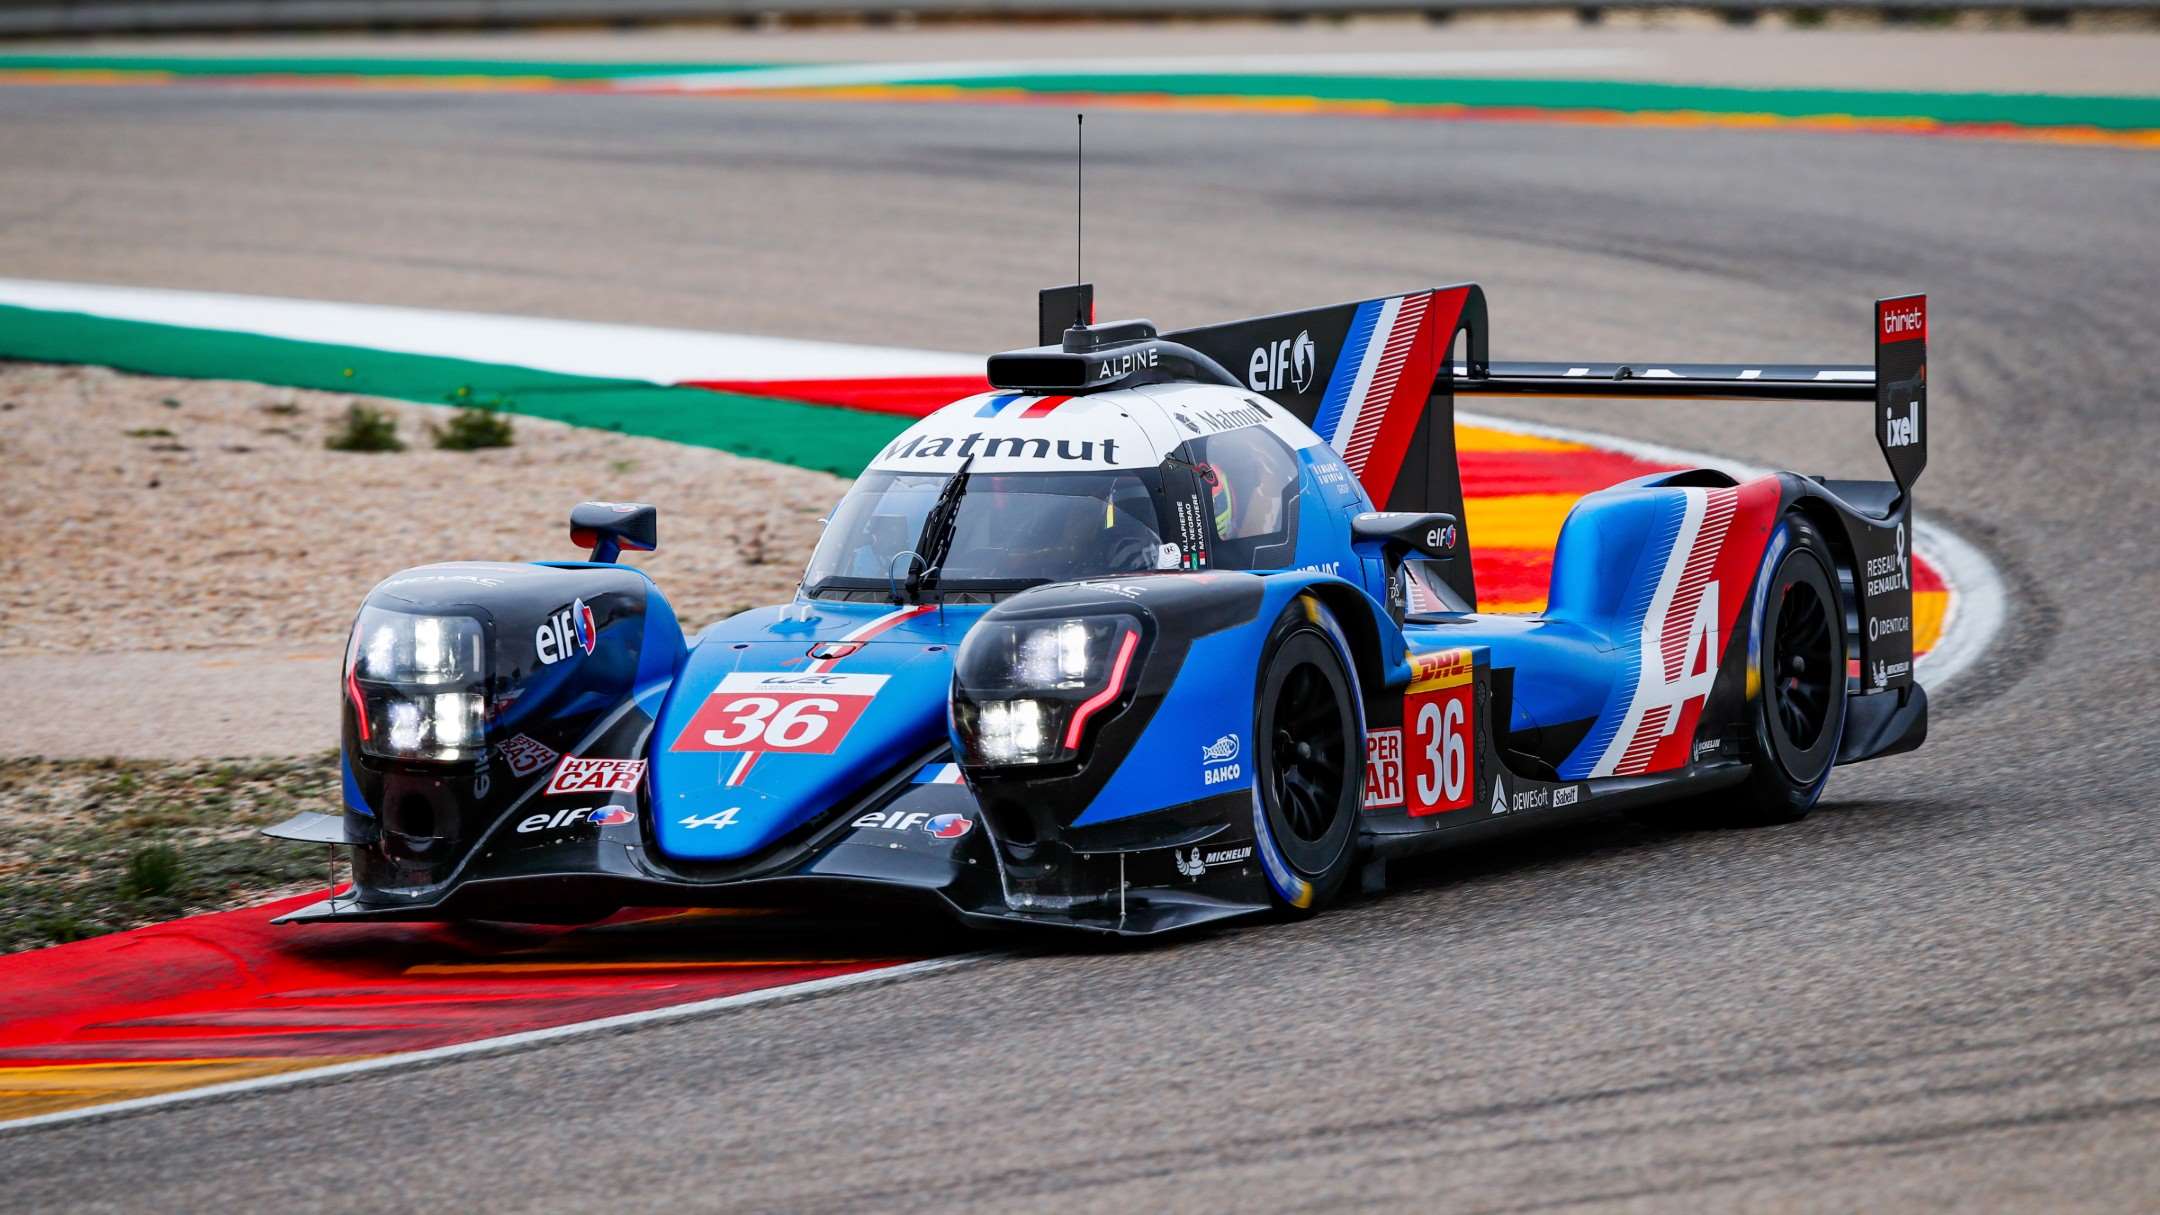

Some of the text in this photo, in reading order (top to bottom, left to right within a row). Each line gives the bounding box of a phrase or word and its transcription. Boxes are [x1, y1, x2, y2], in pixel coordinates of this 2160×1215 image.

[1884, 307, 1922, 334] thiriet
[1099, 348, 1159, 379] ALPINE
[1249, 339, 1291, 392] elf
[1886, 401, 1919, 447] ixell
[879, 432, 1120, 465] Matmut
[1426, 527, 1447, 547] elf
[1867, 554, 1896, 578] RESEAU
[1867, 574, 1902, 597] RENAULT
[536, 609, 575, 665] elf
[1417, 651, 1465, 681] DHL
[703, 697, 840, 748] 36
[1367, 735, 1399, 761] PER
[1416, 698, 1466, 807] 36
[563, 759, 642, 774] HYPER
[1204, 764, 1241, 785] BAHCO
[554, 771, 637, 791] CAR
[1365, 761, 1400, 800] AR
[1512, 787, 1549, 811] DEWESoft
[1554, 787, 1576, 807] Sabelt
[517, 806, 593, 834] elf
[851, 811, 930, 830] elf
[1205, 847, 1252, 865] MICHELIN
